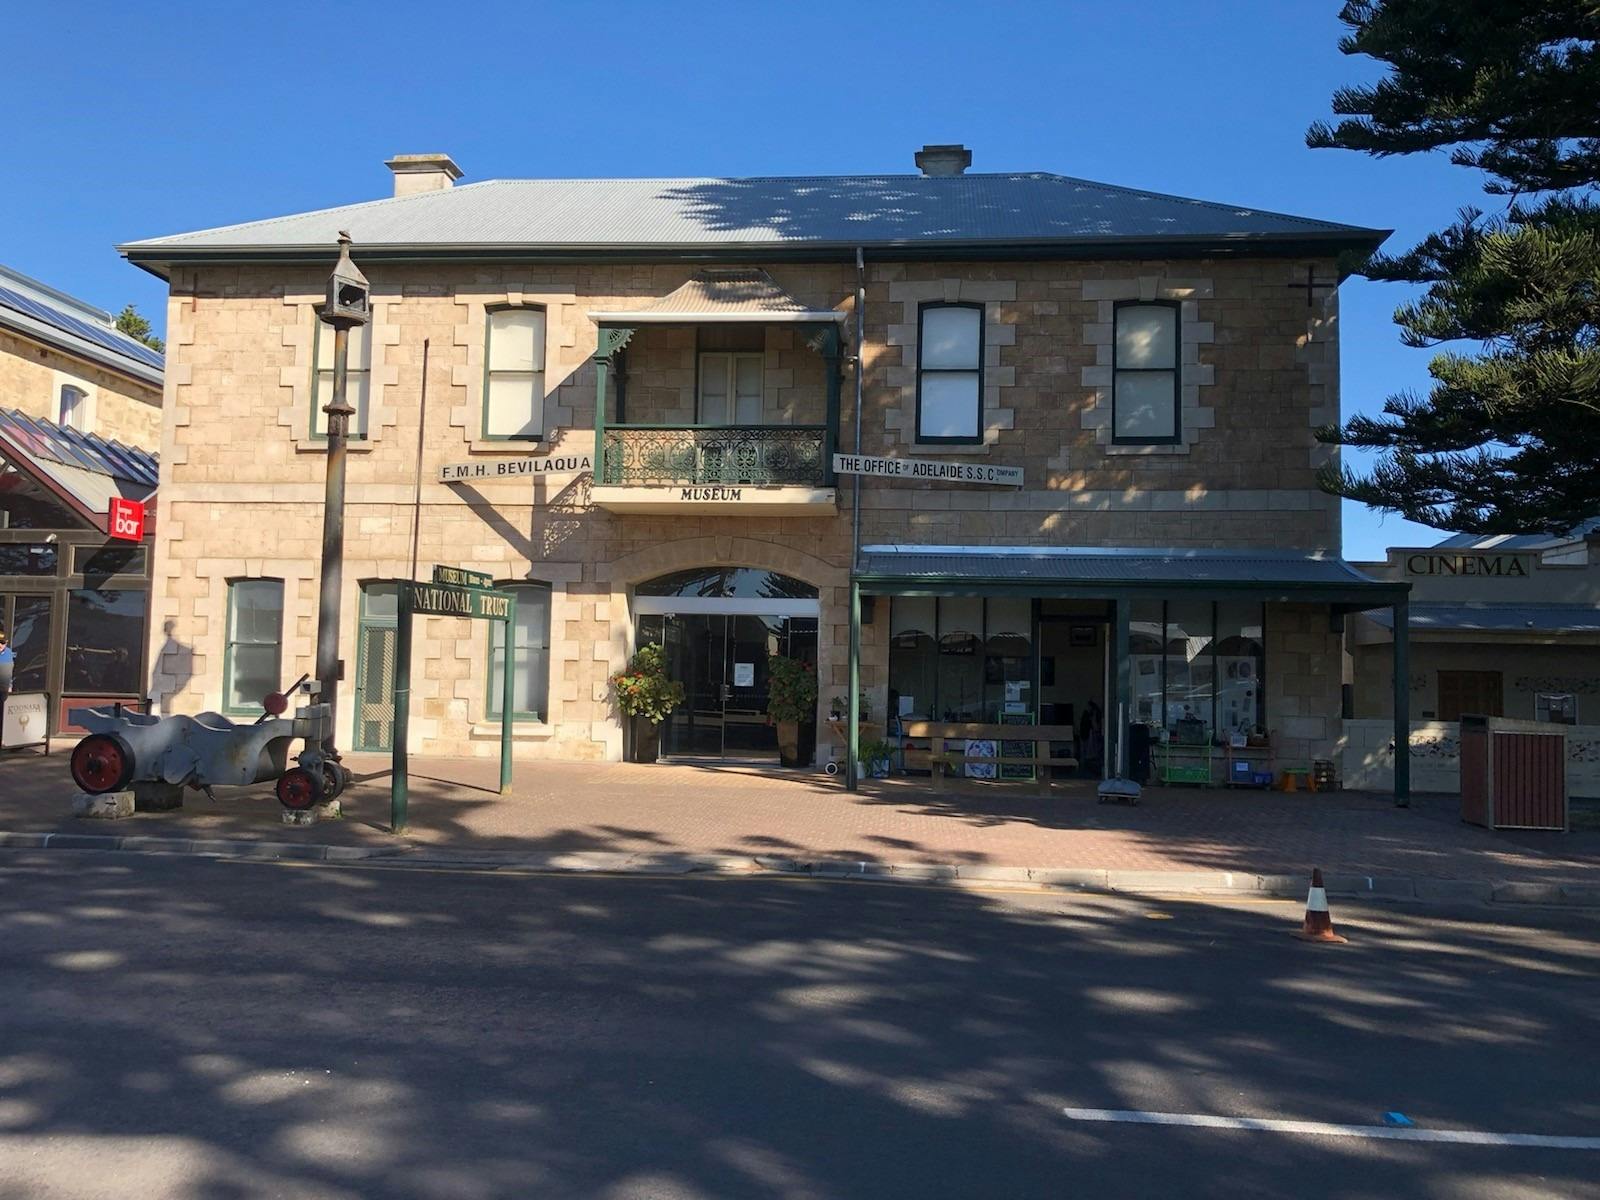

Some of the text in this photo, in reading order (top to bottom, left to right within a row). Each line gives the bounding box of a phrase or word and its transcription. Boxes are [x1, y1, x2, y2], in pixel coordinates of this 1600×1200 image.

[442, 457, 591, 479] F.M.H. BEVILAQUA
[840, 457, 861, 471] THE
[864, 459, 901, 475] OFFICE
[912, 463, 963, 479] ADELAIDE
[681, 487, 741, 501] MUSEUM
[115, 511, 140, 536] bar
[438, 567, 468, 585] MUSEUM
[1407, 554, 1526, 576] CINEMA
[414, 586, 510, 617] NATIONAL TRUST
